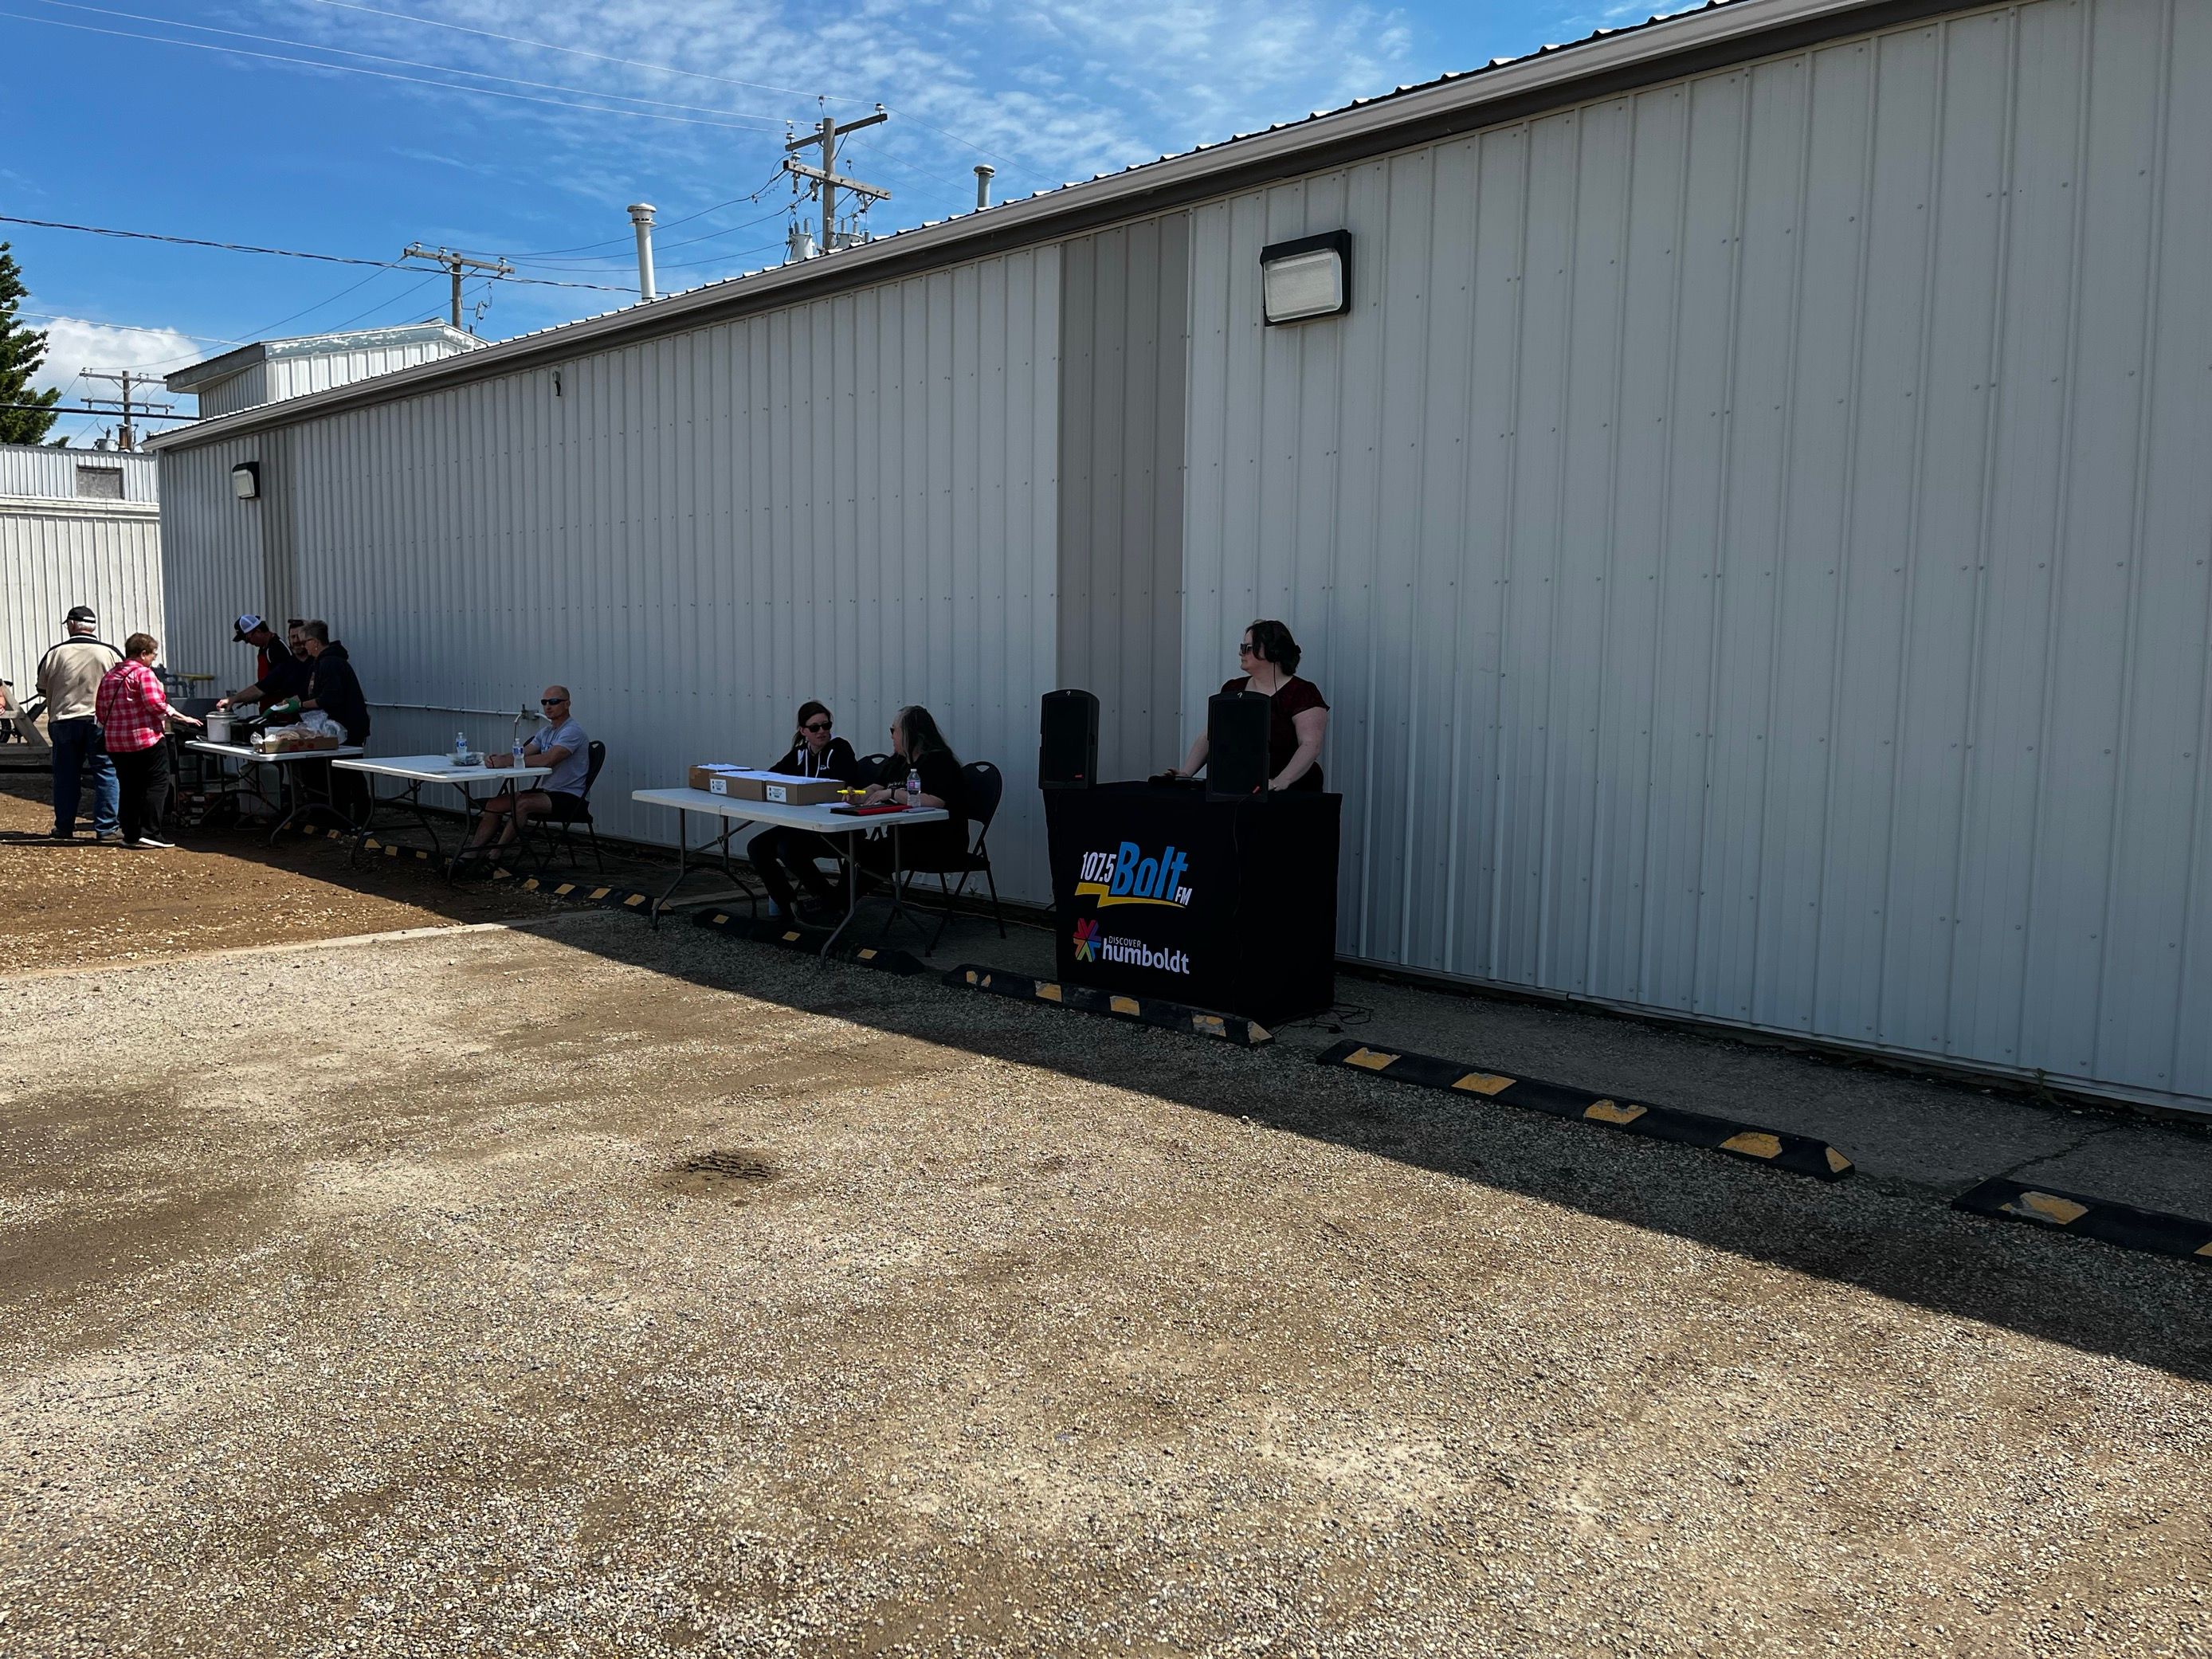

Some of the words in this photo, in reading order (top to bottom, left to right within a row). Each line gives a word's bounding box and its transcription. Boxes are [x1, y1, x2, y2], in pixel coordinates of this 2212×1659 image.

[1081, 851, 1116, 882] 107.5
[1110, 841, 1188, 900] Bolt
[1175, 886, 1193, 906] FM
[1103, 938, 1190, 975] humboldt
[1108, 935, 1142, 948] DISCOVER
